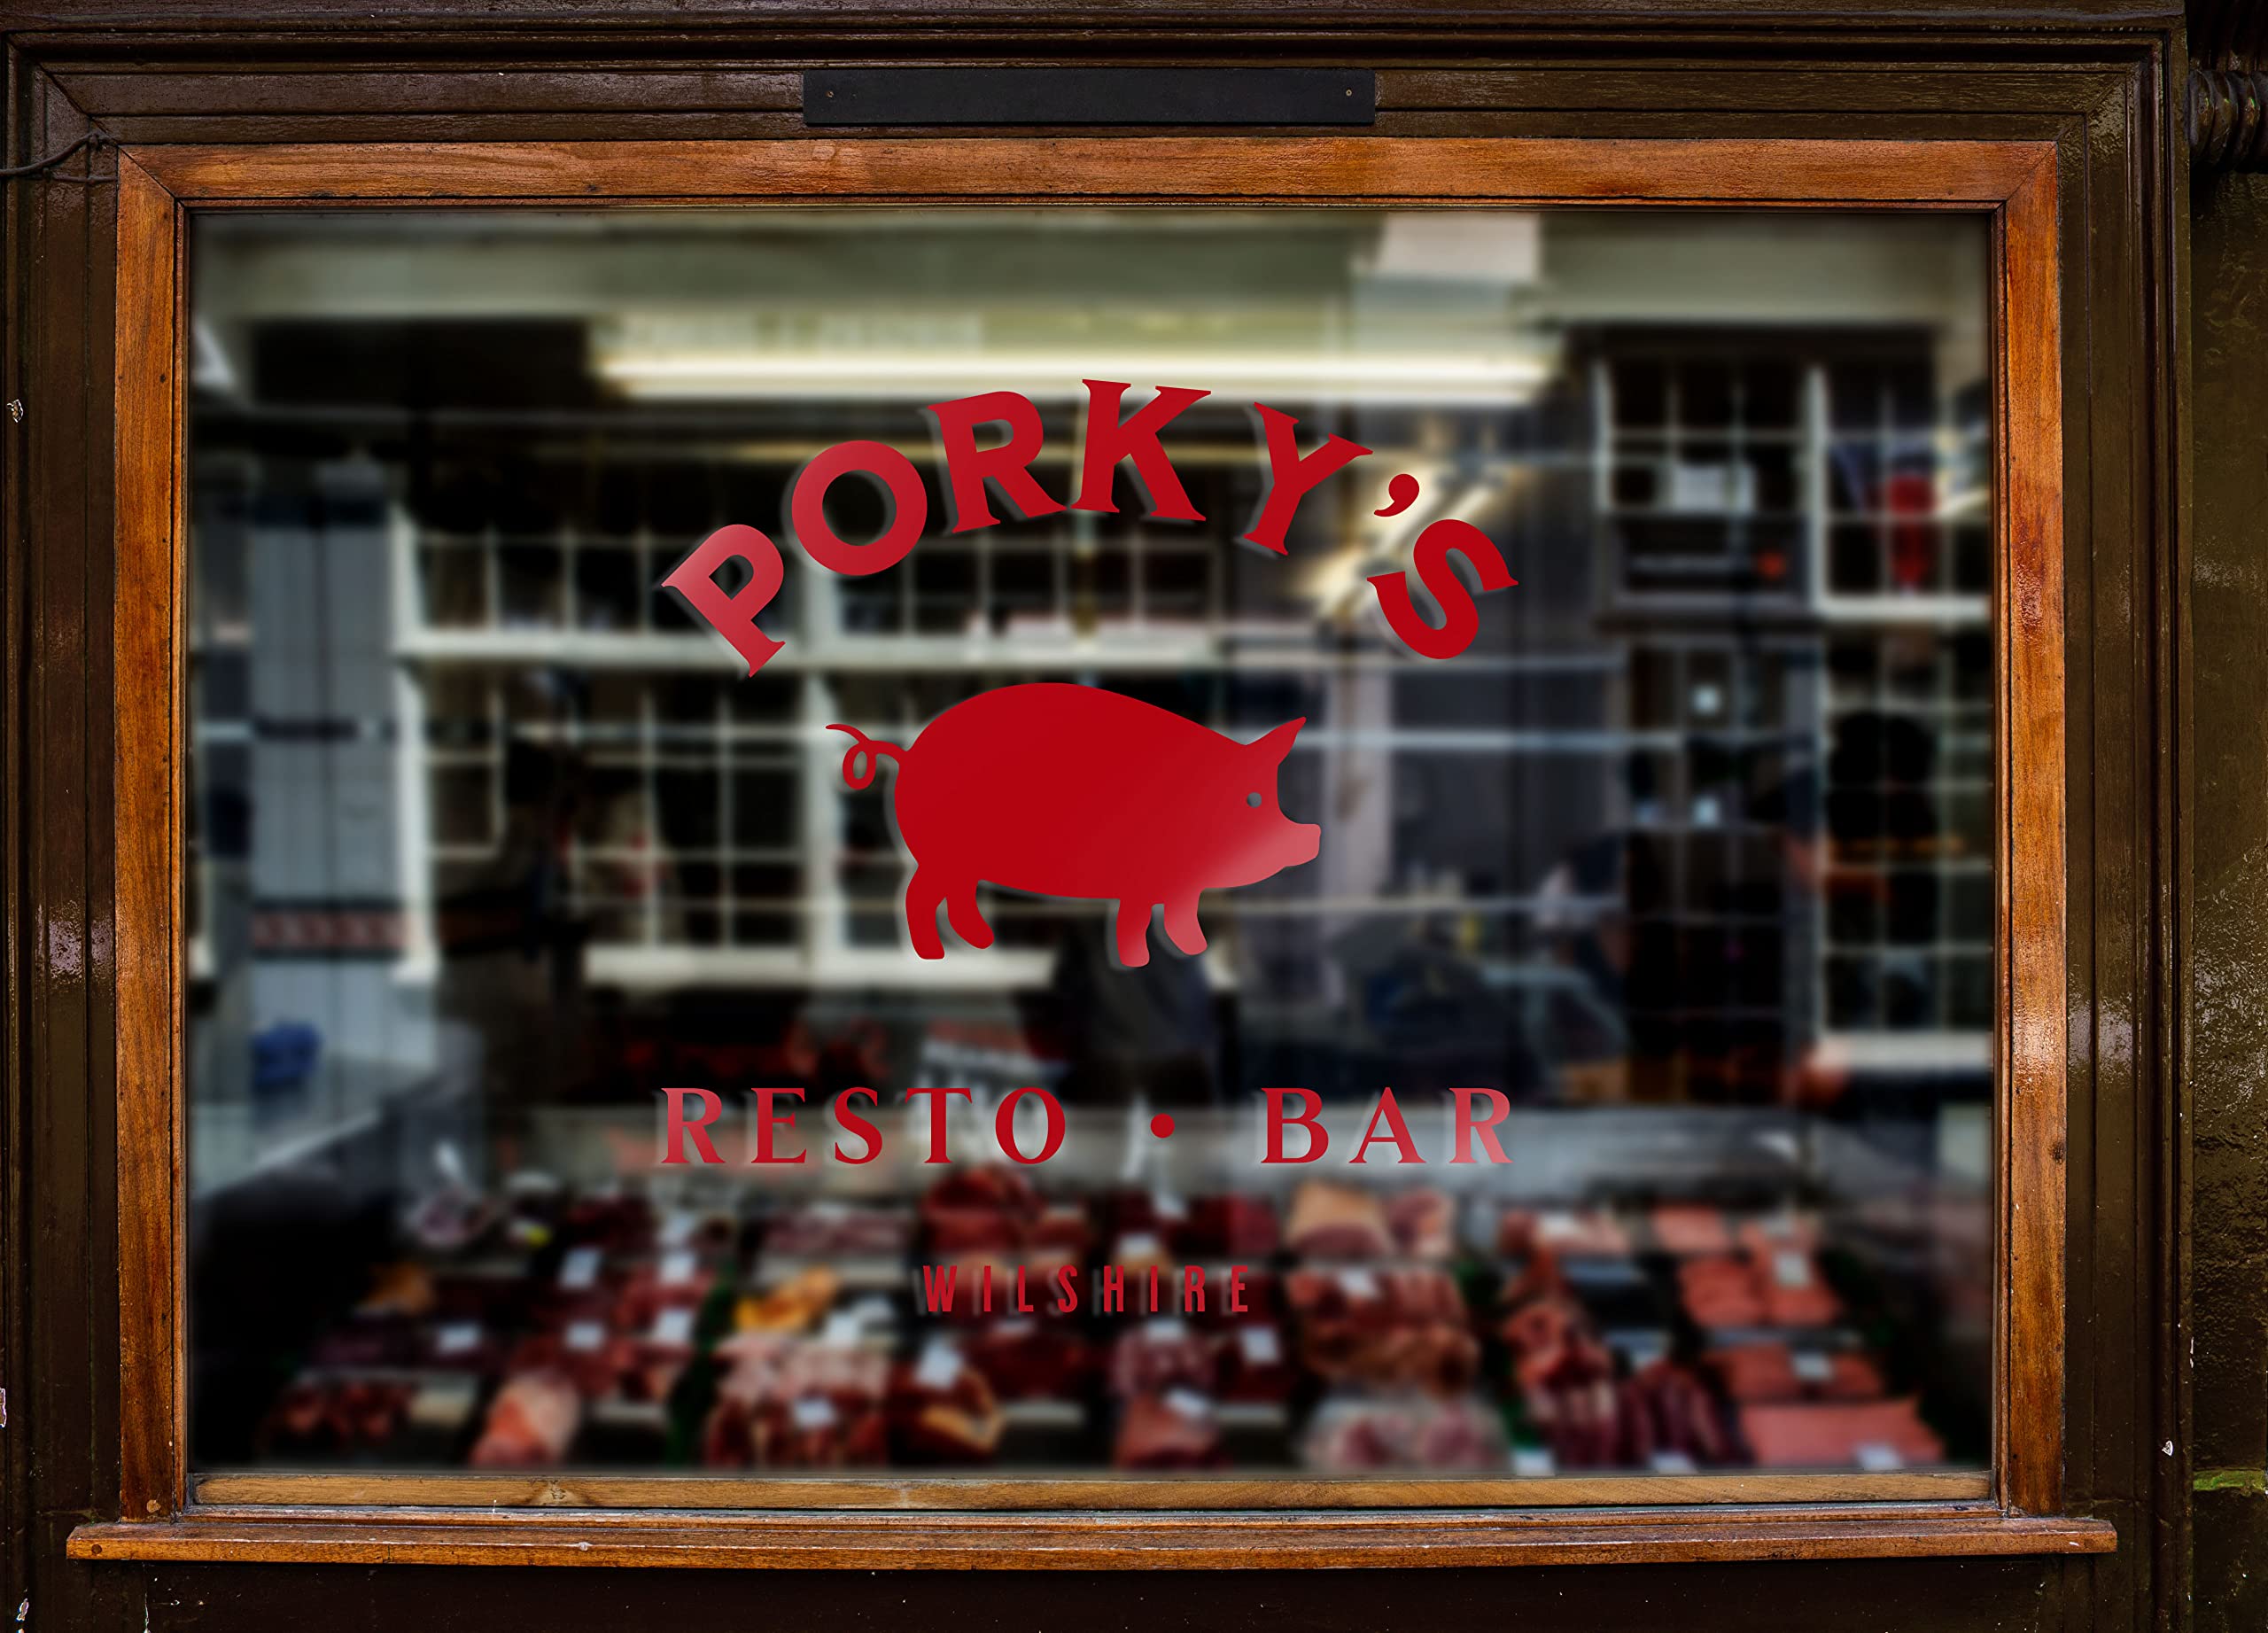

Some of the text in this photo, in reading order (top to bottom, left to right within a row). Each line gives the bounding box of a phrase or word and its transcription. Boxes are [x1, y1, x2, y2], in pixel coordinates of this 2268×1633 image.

[662, 378, 1518, 678] PORKY'S
[661, 1086, 1512, 1164] RESTO BAR
[922, 1264, 1249, 1313] WILSHIRE
